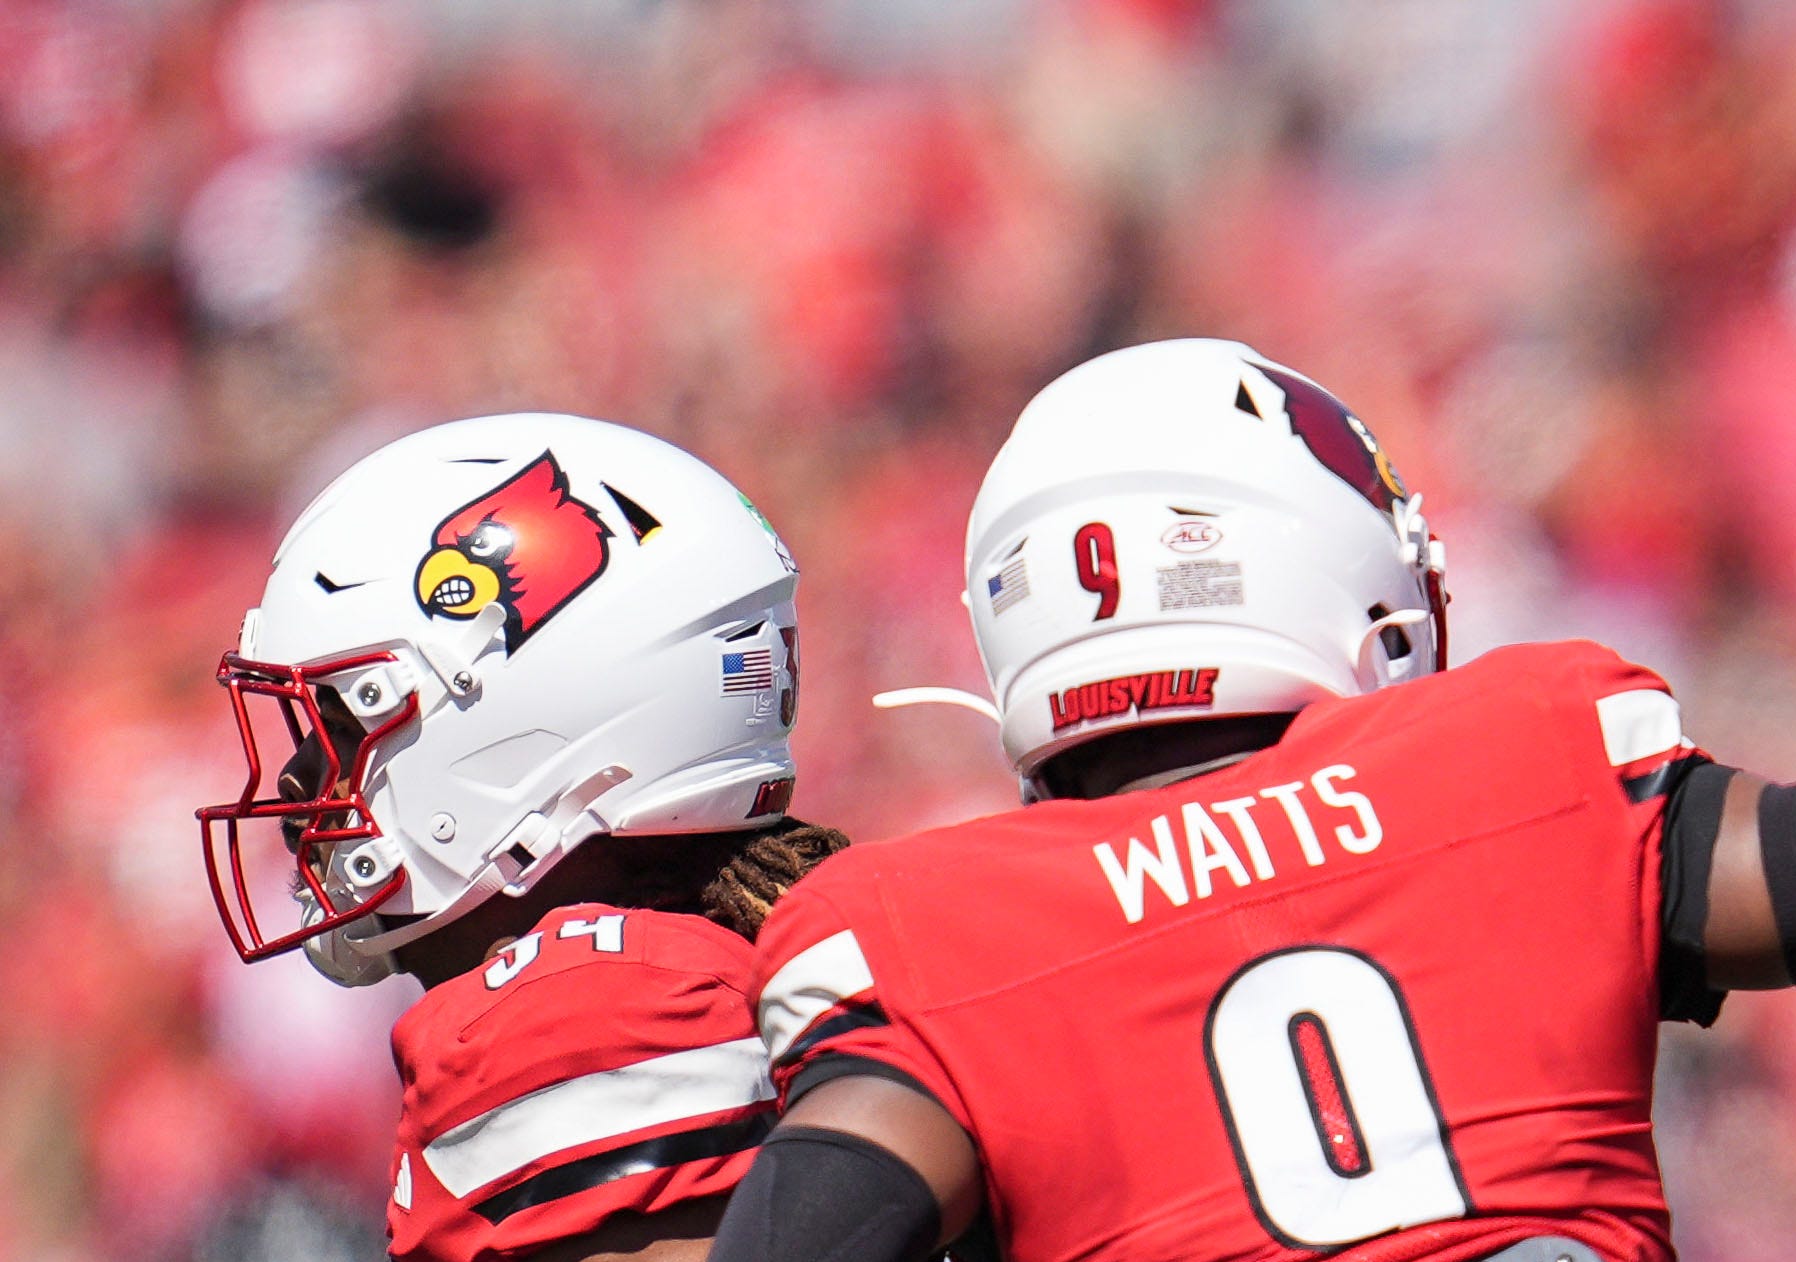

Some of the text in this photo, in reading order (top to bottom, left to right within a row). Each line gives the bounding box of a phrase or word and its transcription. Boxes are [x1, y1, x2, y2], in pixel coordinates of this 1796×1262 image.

[1073, 521, 1120, 622] 9
[1049, 666, 1219, 731] LOUISVILLE
[1093, 764, 1384, 925] WATTS
[1203, 944, 1473, 1254] 0
